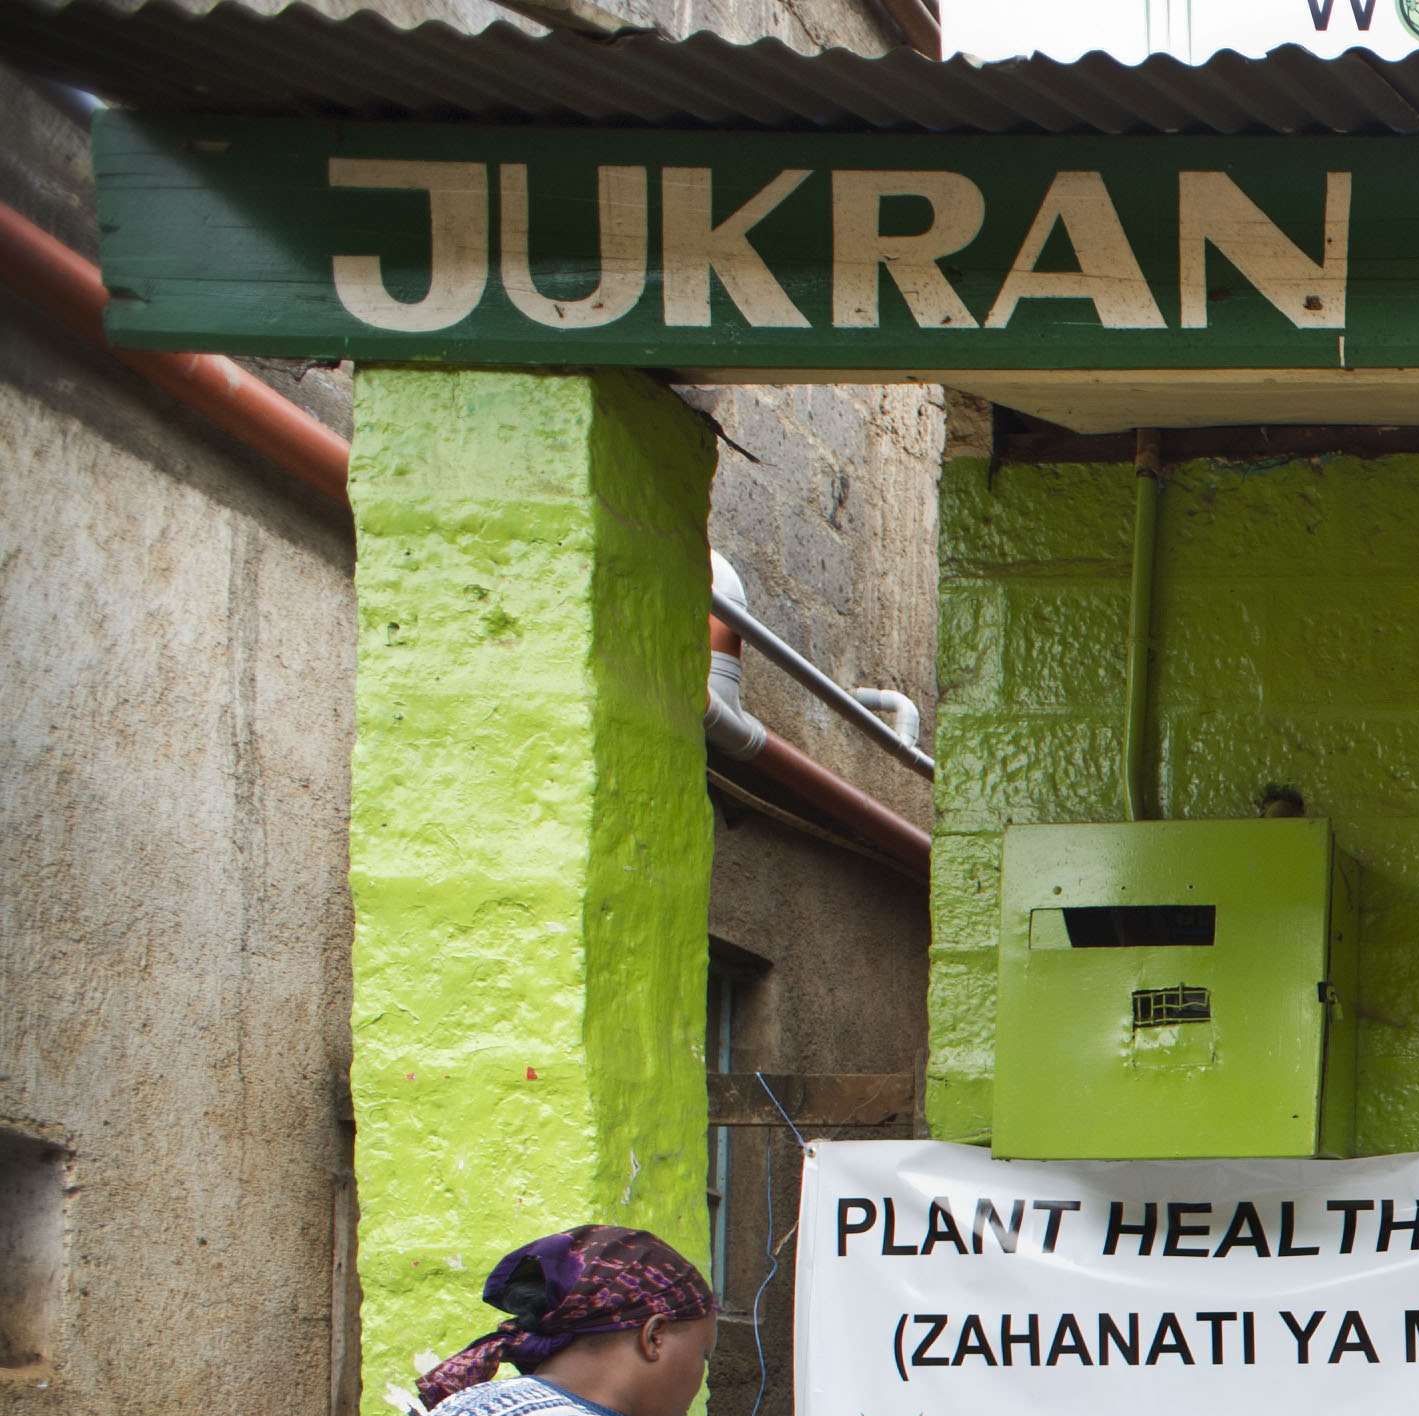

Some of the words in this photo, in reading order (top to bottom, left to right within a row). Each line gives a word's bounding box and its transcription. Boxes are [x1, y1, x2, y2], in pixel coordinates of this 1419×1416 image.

[328, 157, 1353, 334] JUKRAN
[836, 1197, 1081, 1257] PLANT
[894, 1309, 1255, 1382] (ZAHANATI
[1280, 1309, 1380, 1366] YA
